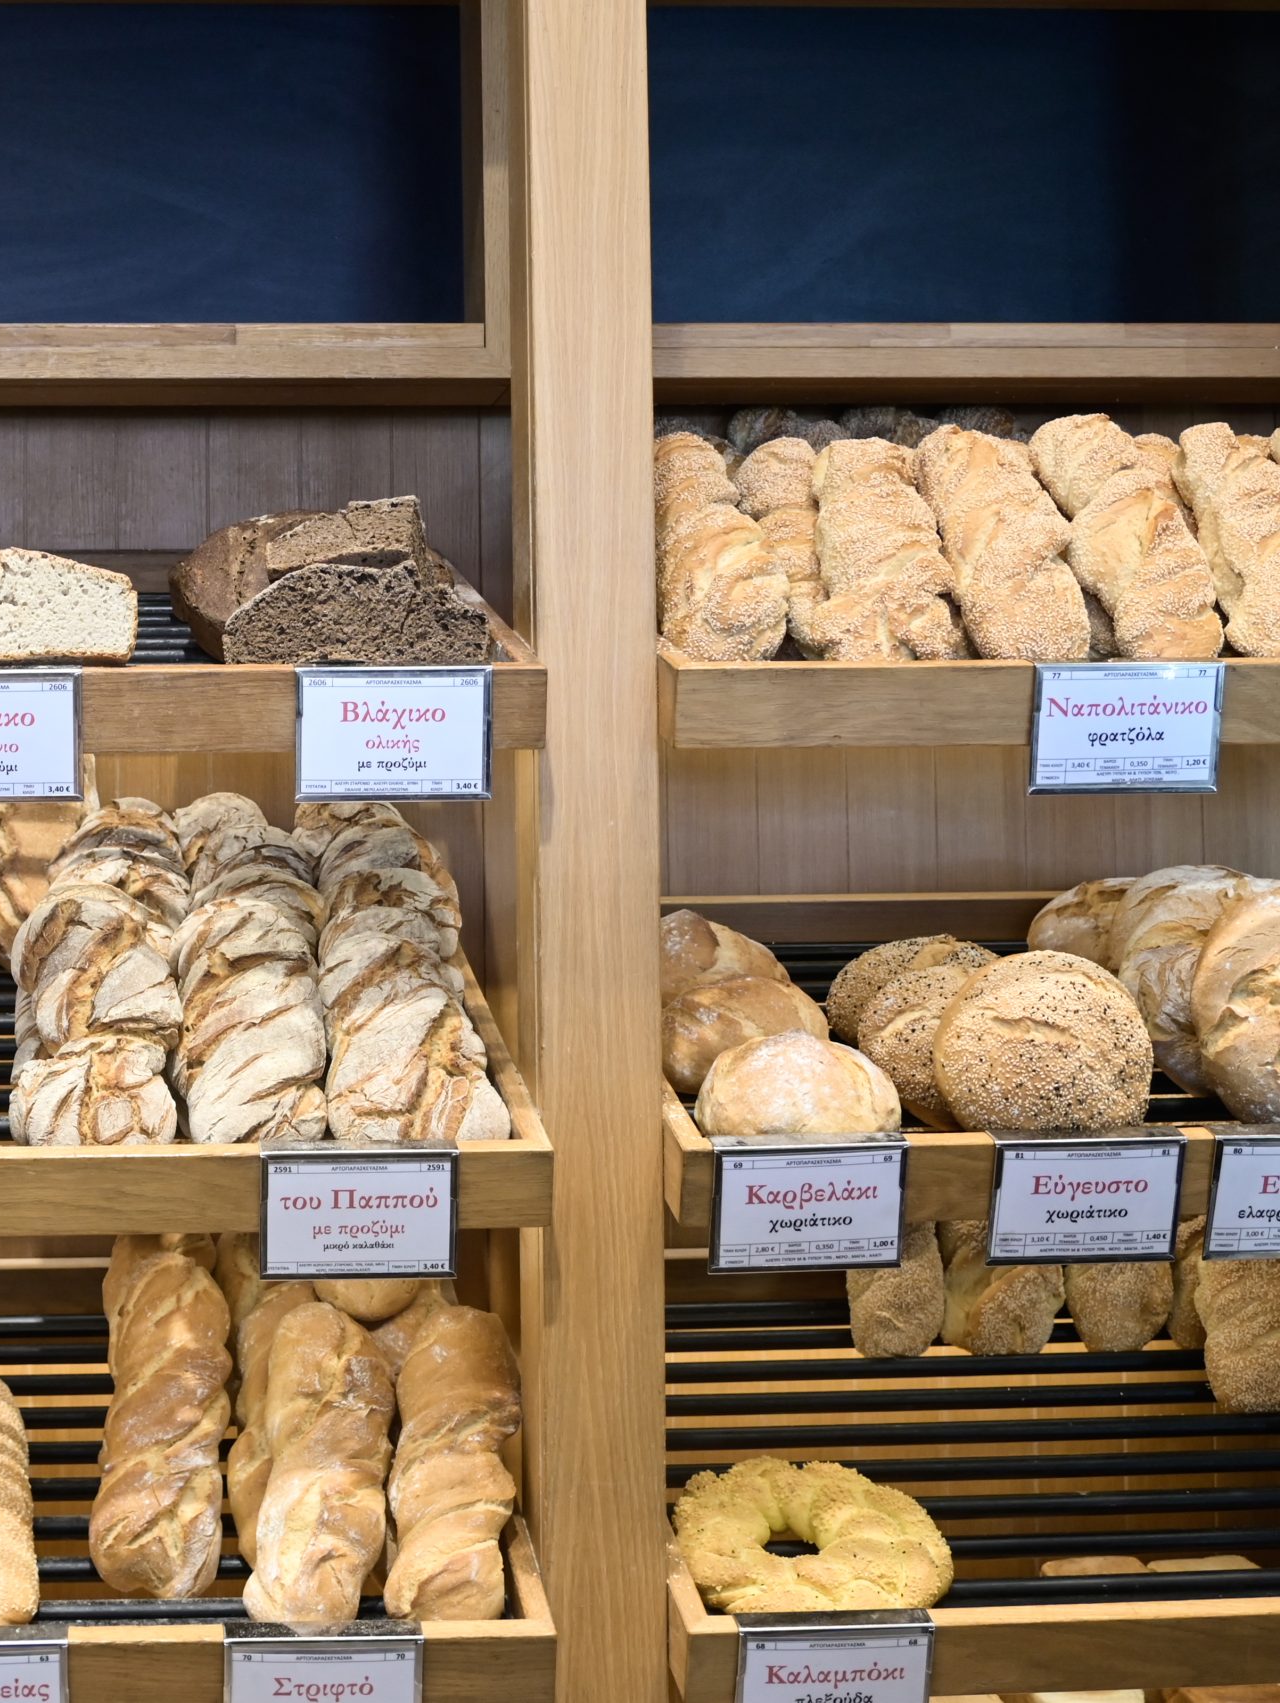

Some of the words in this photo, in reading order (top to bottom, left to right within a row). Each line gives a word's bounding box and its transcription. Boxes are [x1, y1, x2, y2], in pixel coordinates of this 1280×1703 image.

[340, 701, 446, 730] Βλάχικο
[1046, 695, 1208, 718] Ναπολιτάνικο
[365, 735, 420, 754] ολικής
[1088, 727, 1164, 746] φρατζόλα
[358, 760, 372, 771] με
[376, 757, 427, 772] προζύμι
[1186, 759, 1202, 767] 1,20
[745, 1180, 878, 1210] Καρβελάκι
[1031, 1174, 1148, 1201] Εύγευστο
[280, 1196, 322, 1210] του
[331, 1187, 438, 1210] Παππού
[769, 1213, 853, 1233] χωριάτικο
[1045, 1205, 1128, 1223] χωριάτικο
[313, 1225, 331, 1239] με
[338, 1221, 405, 1238] προζύμι
[324, 1241, 350, 1252] μικρό
[353, 1241, 394, 1249] καλαθάκι
[765, 1662, 904, 1689] Καλαμπόκι
[273, 1676, 373, 1702] Στριφτό
